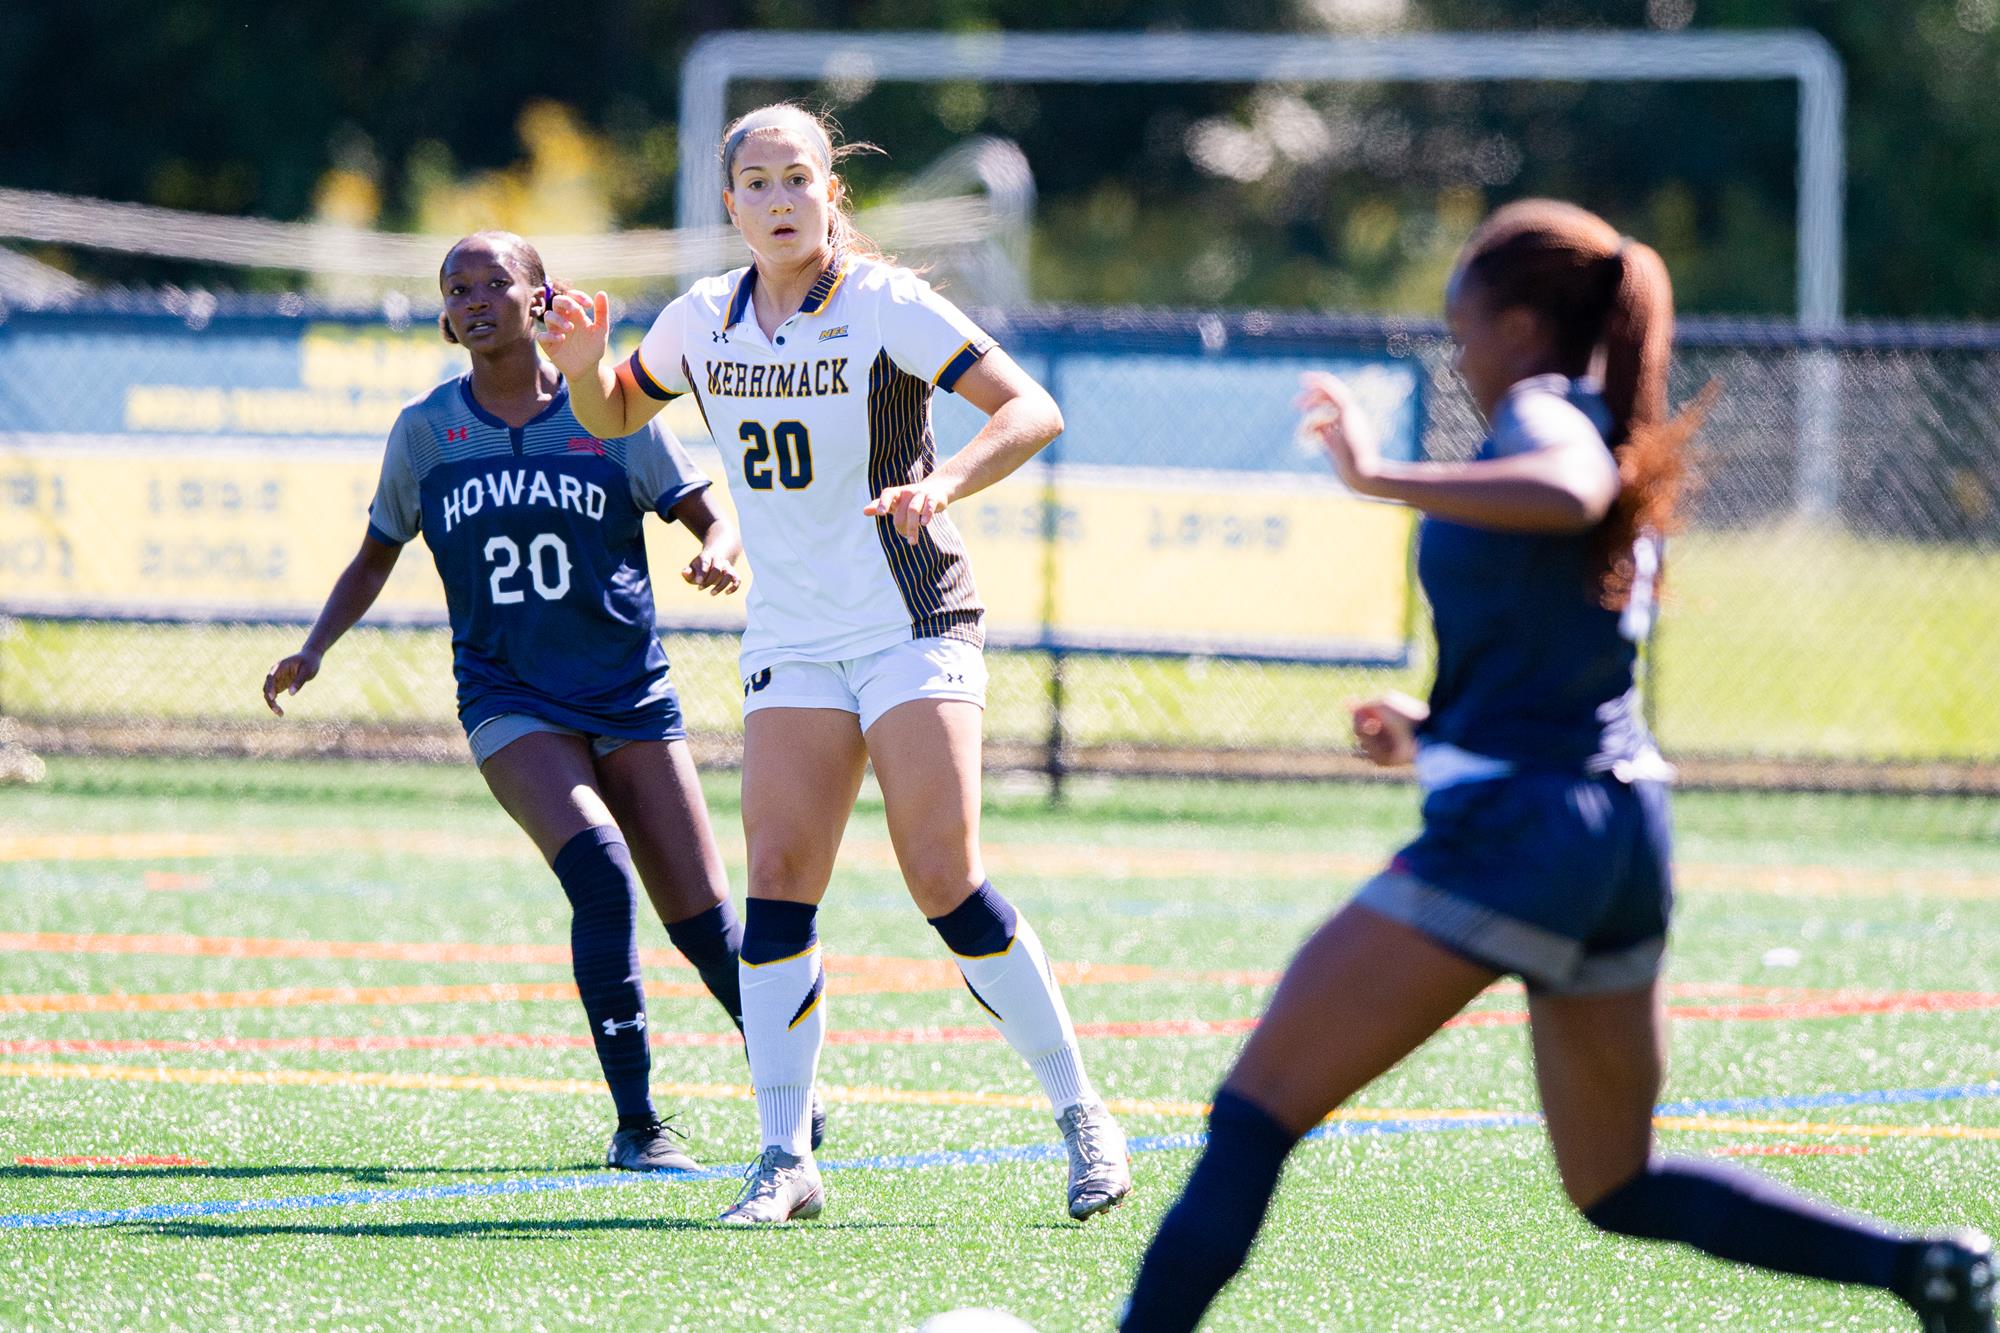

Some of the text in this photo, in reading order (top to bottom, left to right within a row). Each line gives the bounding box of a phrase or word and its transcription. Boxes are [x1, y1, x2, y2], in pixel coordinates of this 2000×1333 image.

[706, 357, 850, 399] MERRIMACK
[738, 419, 814, 491] 20
[443, 469, 607, 533] HOWARD
[484, 533, 573, 604] 20
